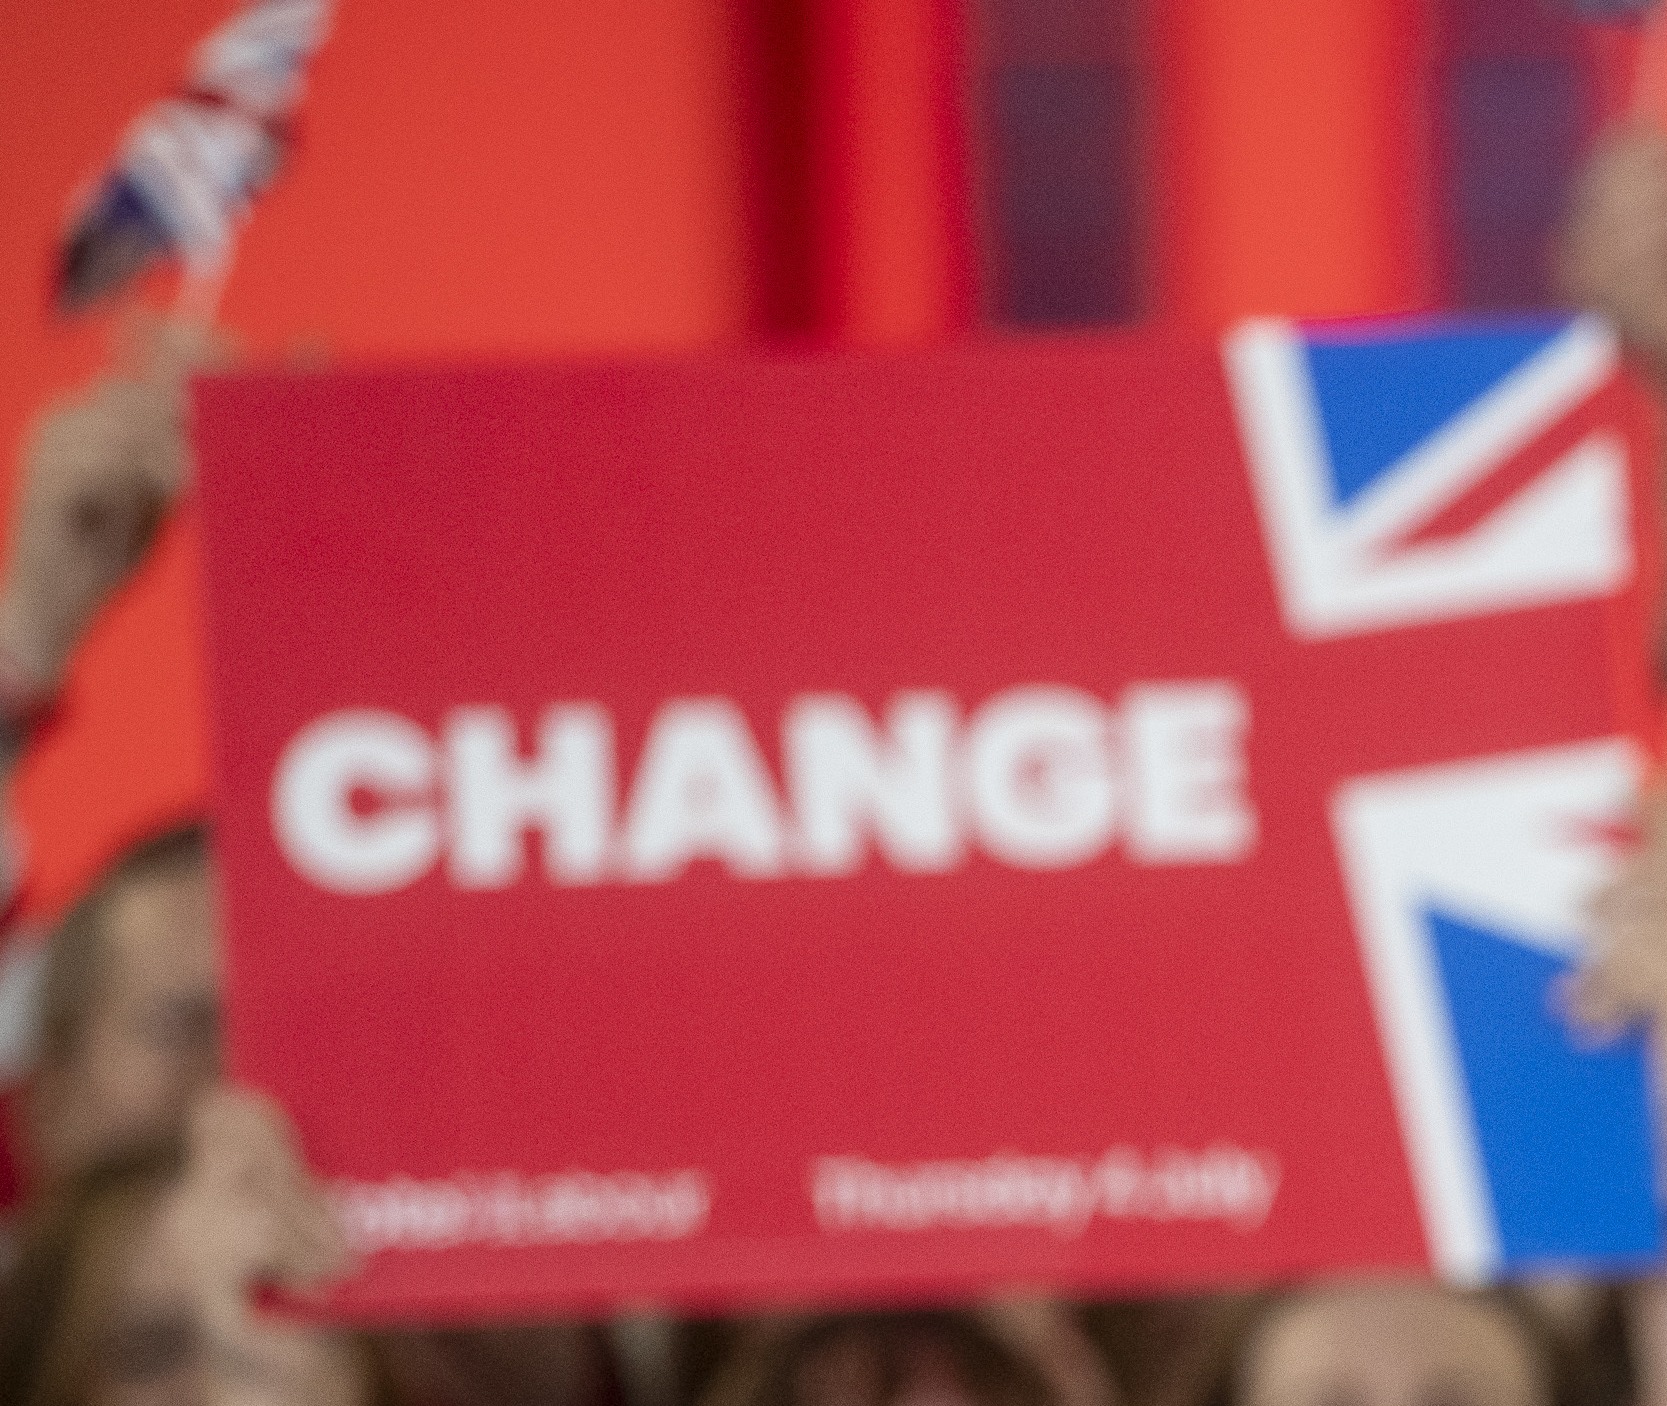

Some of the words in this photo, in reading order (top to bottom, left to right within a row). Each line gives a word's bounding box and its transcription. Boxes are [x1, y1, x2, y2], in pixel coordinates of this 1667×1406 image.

[270, 683, 1252, 894] CHANGE
[810, 1151, 1096, 1238] Thursday
[1152, 1139, 1282, 1234] July
